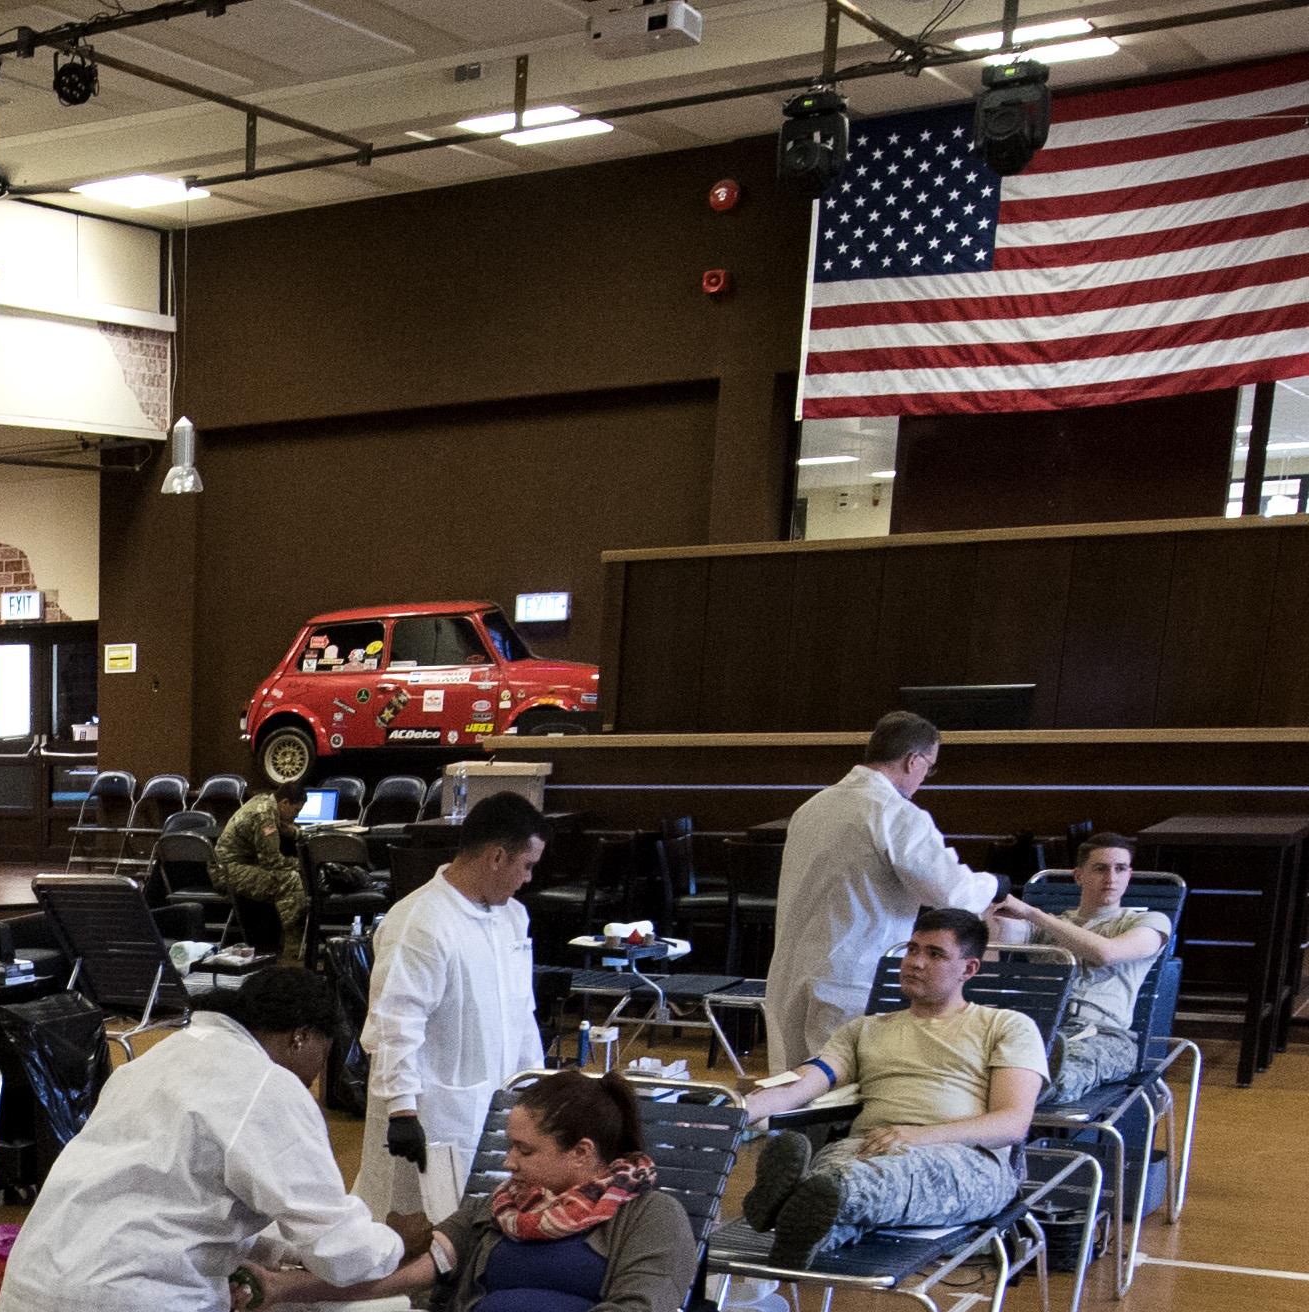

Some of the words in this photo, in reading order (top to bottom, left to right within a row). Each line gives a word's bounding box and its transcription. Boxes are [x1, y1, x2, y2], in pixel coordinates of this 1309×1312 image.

[9, 595, 32, 617] EXIT
[525, 596, 559, 619] EXIT
[389, 729, 441, 740] ACDelco
